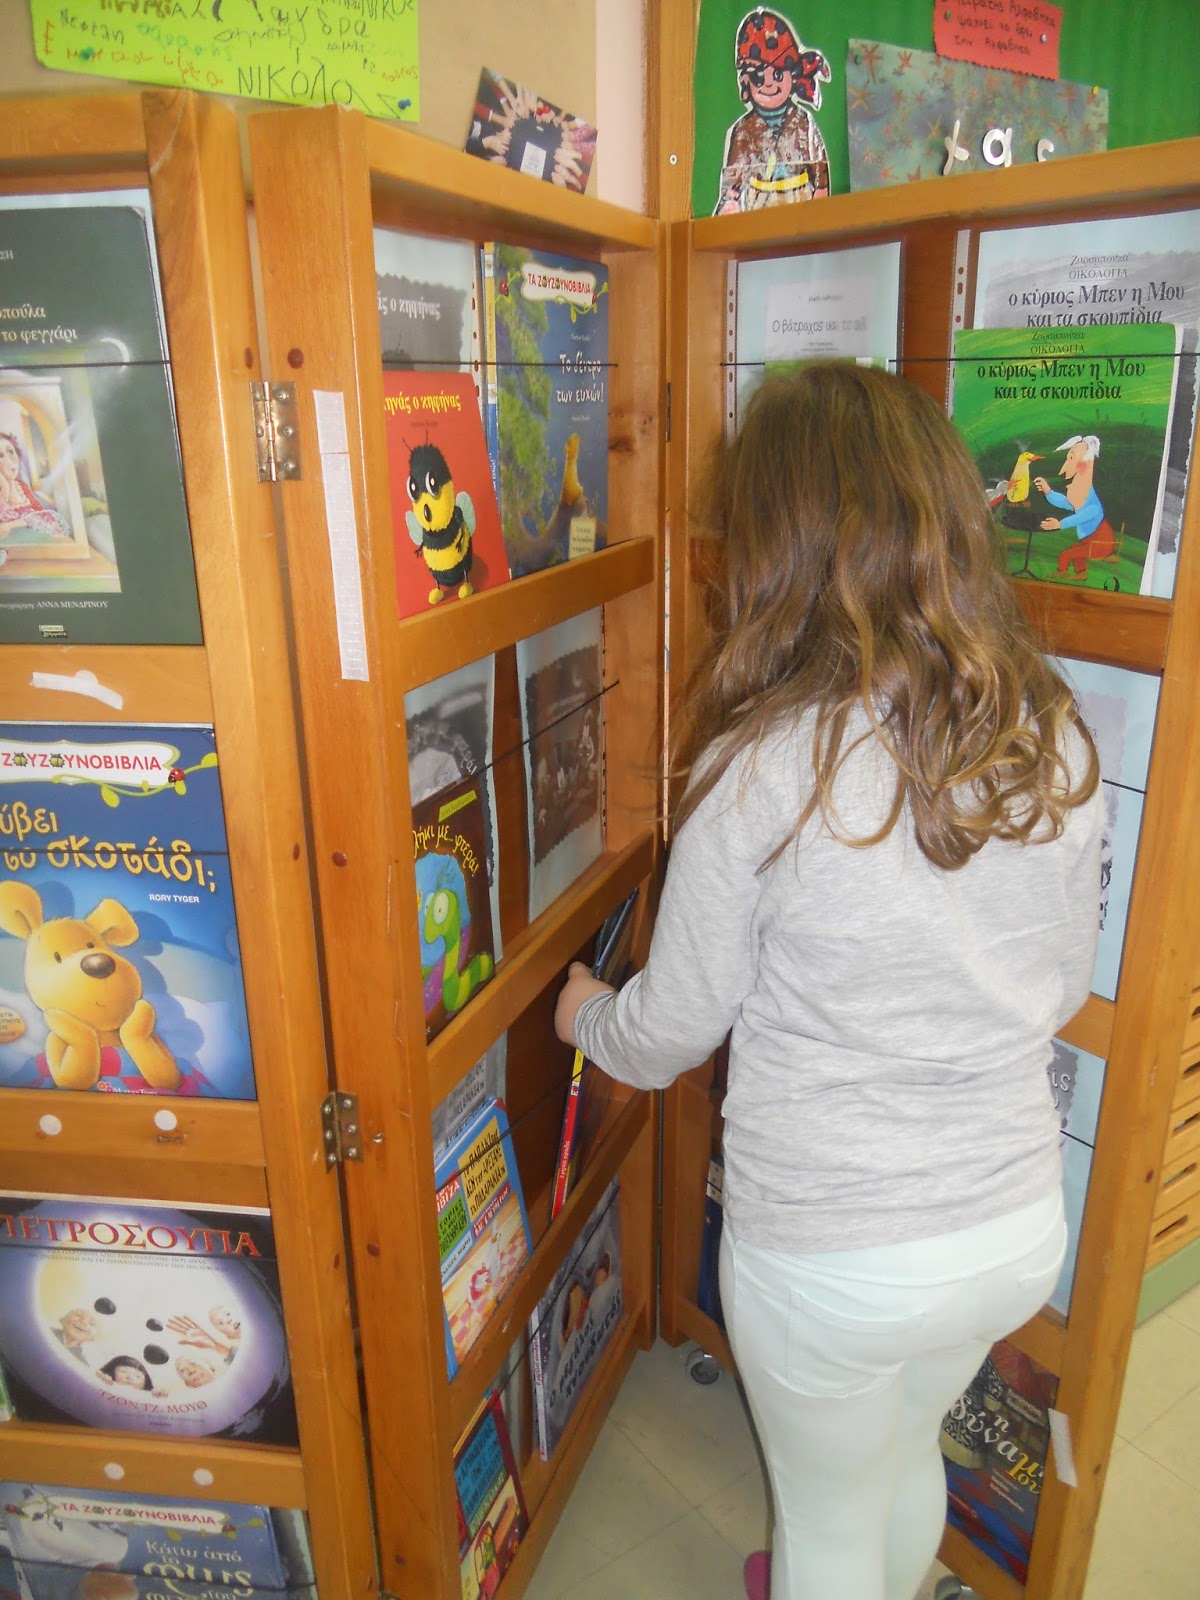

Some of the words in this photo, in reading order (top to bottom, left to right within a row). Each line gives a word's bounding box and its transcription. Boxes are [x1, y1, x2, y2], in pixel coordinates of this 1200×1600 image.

[1068, 268, 1128, 280] ΟΙΚΟΛΟΓΙΑ
[1021, 288, 1075, 308] κύριος
[1078, 284, 1127, 304] Μπεν
[1146, 281, 1185, 302] Μου
[1076, 306, 1163, 327] σκουπίδια
[20, 324, 79, 345] φεγγάρι
[1030, 344, 1086, 355] ΟΙΚΟΛΟΓΙΑ
[988, 358, 1037, 381] κύριος
[1040, 359, 1089, 377] Μπεν
[1104, 357, 1146, 376] Μου
[994, 384, 1019, 399] και
[1020, 386, 1037, 399] τα
[1040, 381, 1122, 400] σκουπίδια
[0, 801, 58, 842] ύβει
[149, 893, 171, 902] RORY
[173, 894, 200, 904] TYGER
[60, 1502, 79, 1513] ΤΑ
